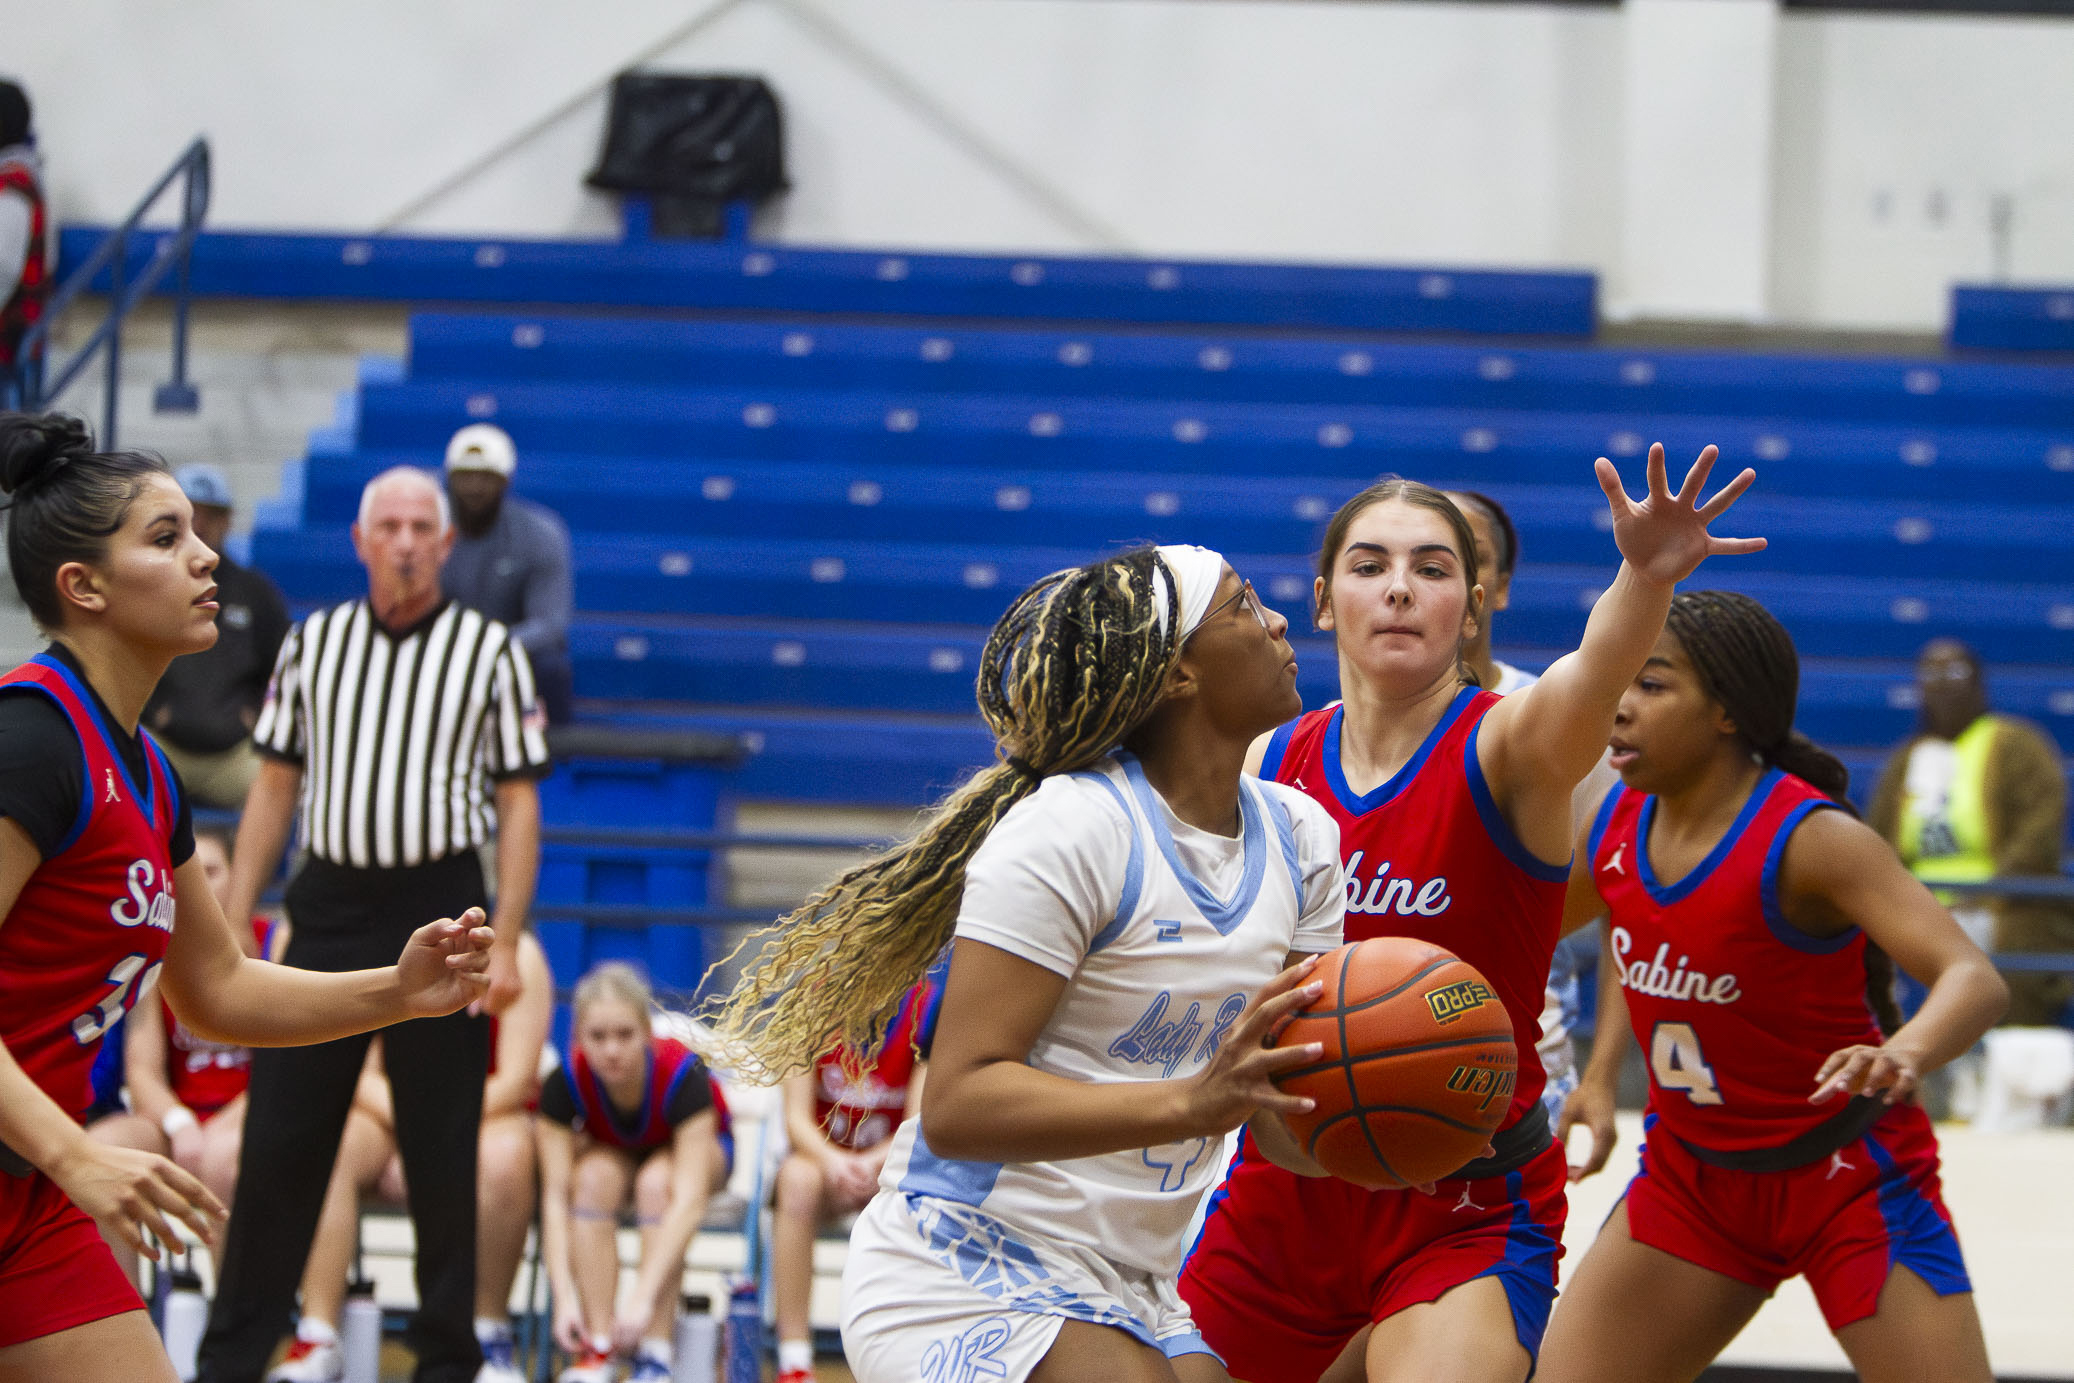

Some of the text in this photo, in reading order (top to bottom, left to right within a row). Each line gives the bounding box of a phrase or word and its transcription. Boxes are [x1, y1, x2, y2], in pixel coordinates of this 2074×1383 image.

[1343, 849, 1452, 917] bine
[1610, 926, 1743, 1005] Sabine
[1107, 990, 1203, 1079] Lady
[1651, 1020, 1726, 1108] 4
